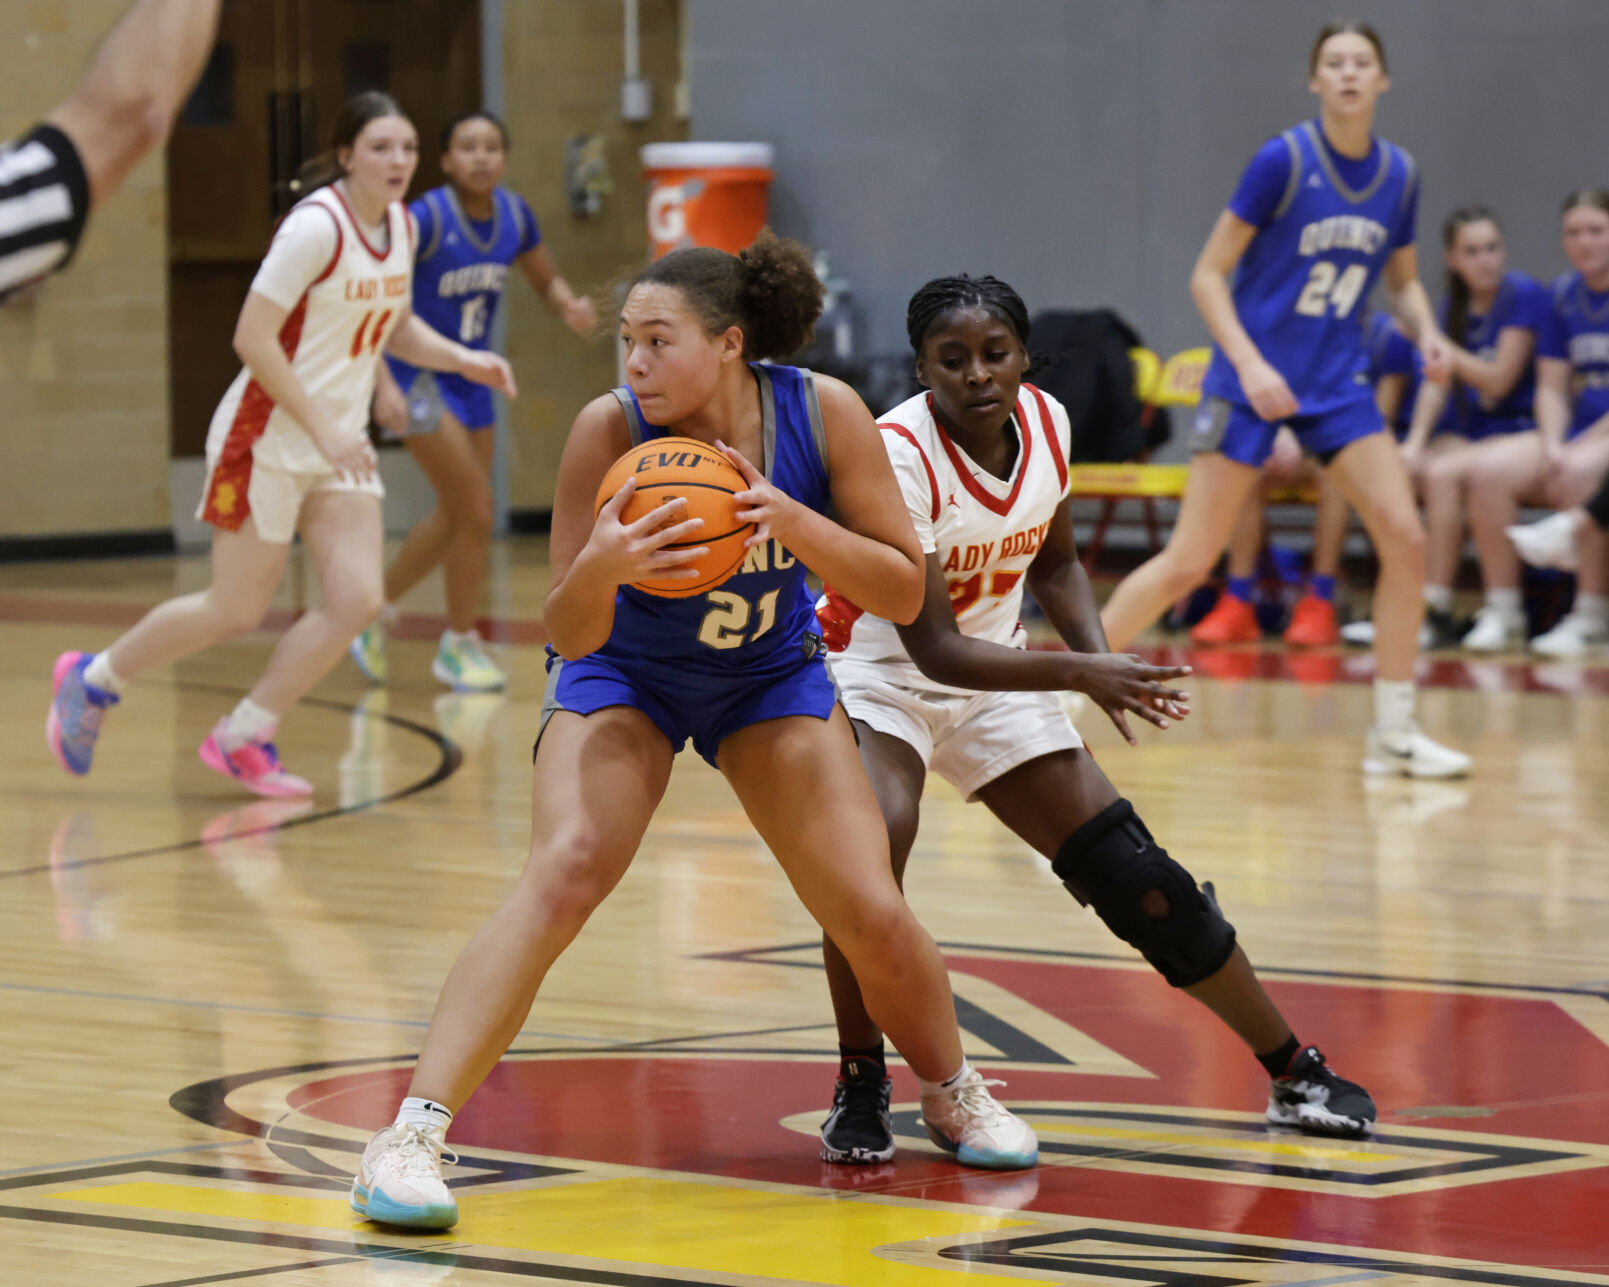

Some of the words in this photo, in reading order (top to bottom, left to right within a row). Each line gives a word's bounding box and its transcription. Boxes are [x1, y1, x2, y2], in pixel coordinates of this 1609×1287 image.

[647, 186, 685, 243] G
[1295, 261, 1367, 318] 24
[636, 452, 702, 473] EVO
[937, 541, 995, 573] ADY
[697, 587, 782, 651] 21
